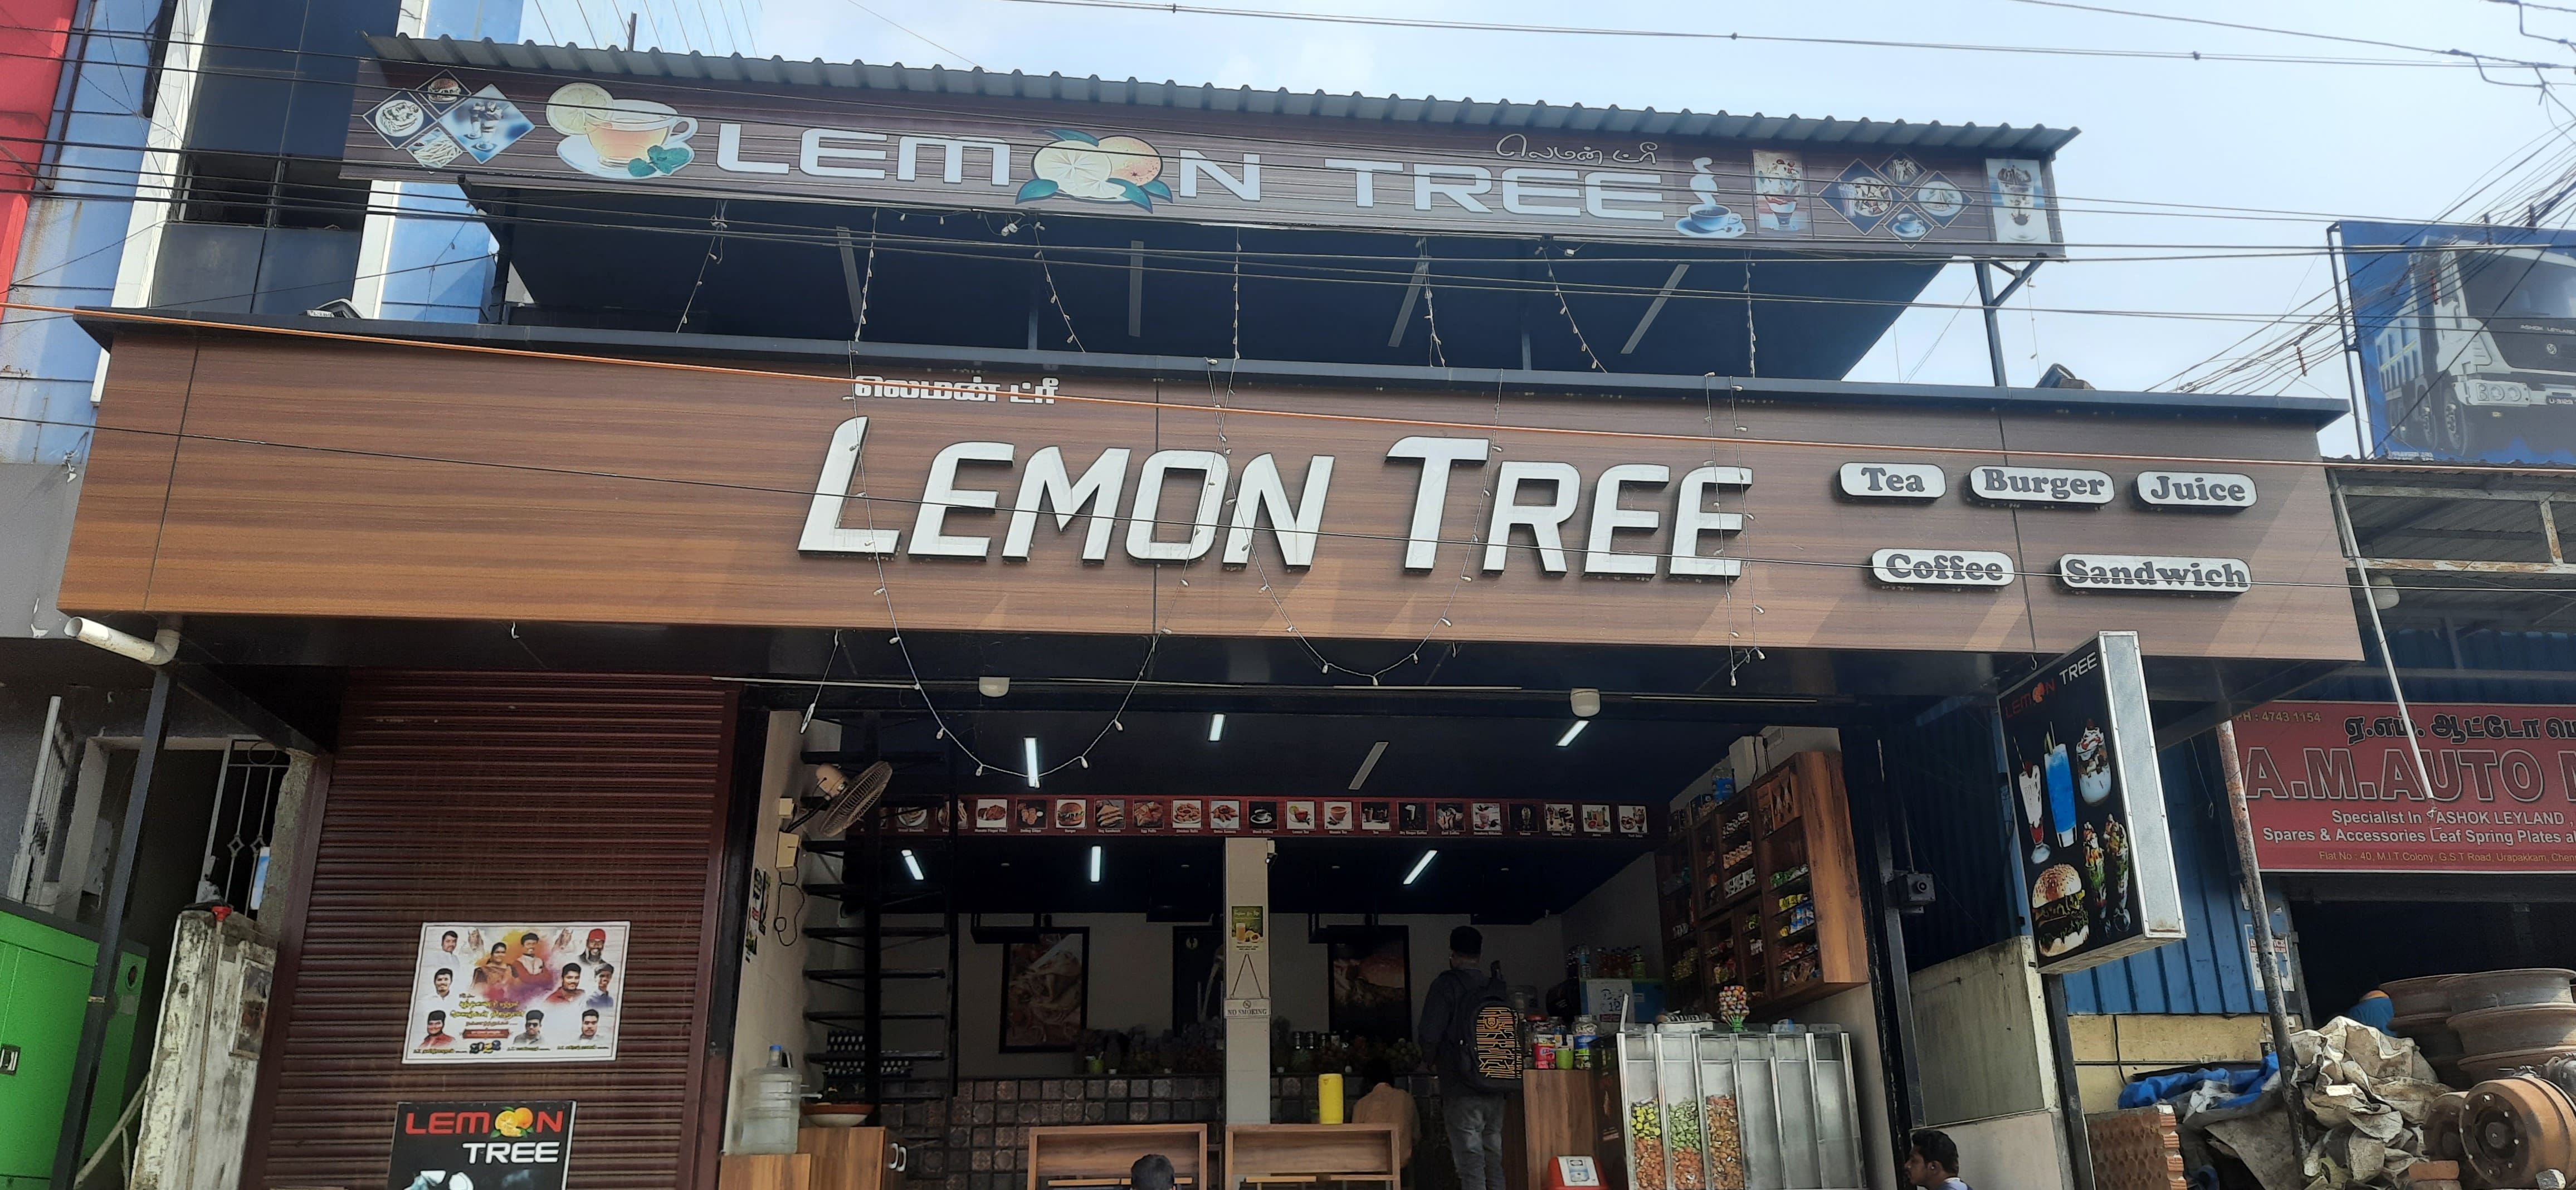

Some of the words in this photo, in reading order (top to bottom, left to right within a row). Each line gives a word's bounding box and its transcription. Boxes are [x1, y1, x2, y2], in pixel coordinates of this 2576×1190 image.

[1495, 133, 1603, 165] லெமன்
[1324, 158, 1665, 221] TREE
[854, 375, 1001, 402] லெமன்
[1860, 466, 1926, 492] Tea
[1982, 468, 2105, 500] Burger
[2150, 475, 2246, 501] Juice
[797, 415, 1336, 572] LEMON
[1384, 435, 1754, 580] TREE
[1886, 553, 2003, 582] Coffee
[2065, 559, 2247, 588] Sandwich
[2059, 651, 2098, 685] TREE
[2262, 711, 2290, 722] 4743
[2294, 711, 2321, 723] 1154
[2430, 713, 2540, 745] ஆட்டோ
[2332, 809, 2406, 826] Specialist
[2408, 811, 2422, 824] In
[2436, 811, 2491, 825] ASHOK
[2494, 811, 2565, 825] LEYLAND
[2263, 827, 2315, 843] Spares
[2320, 828, 2331, 841] &
[2335, 828, 2426, 842] Accessories
[2429, 828, 2461, 842] Leaf
[2465, 829, 2514, 846] Spring
[2517, 830, 2562, 843] Plates
[2319, 851, 2336, 860] Flat
[2339, 851, 2352, 861] No
[2551, 853, 2576, 862] Chen
[462, 1142, 561, 1164] TREE
